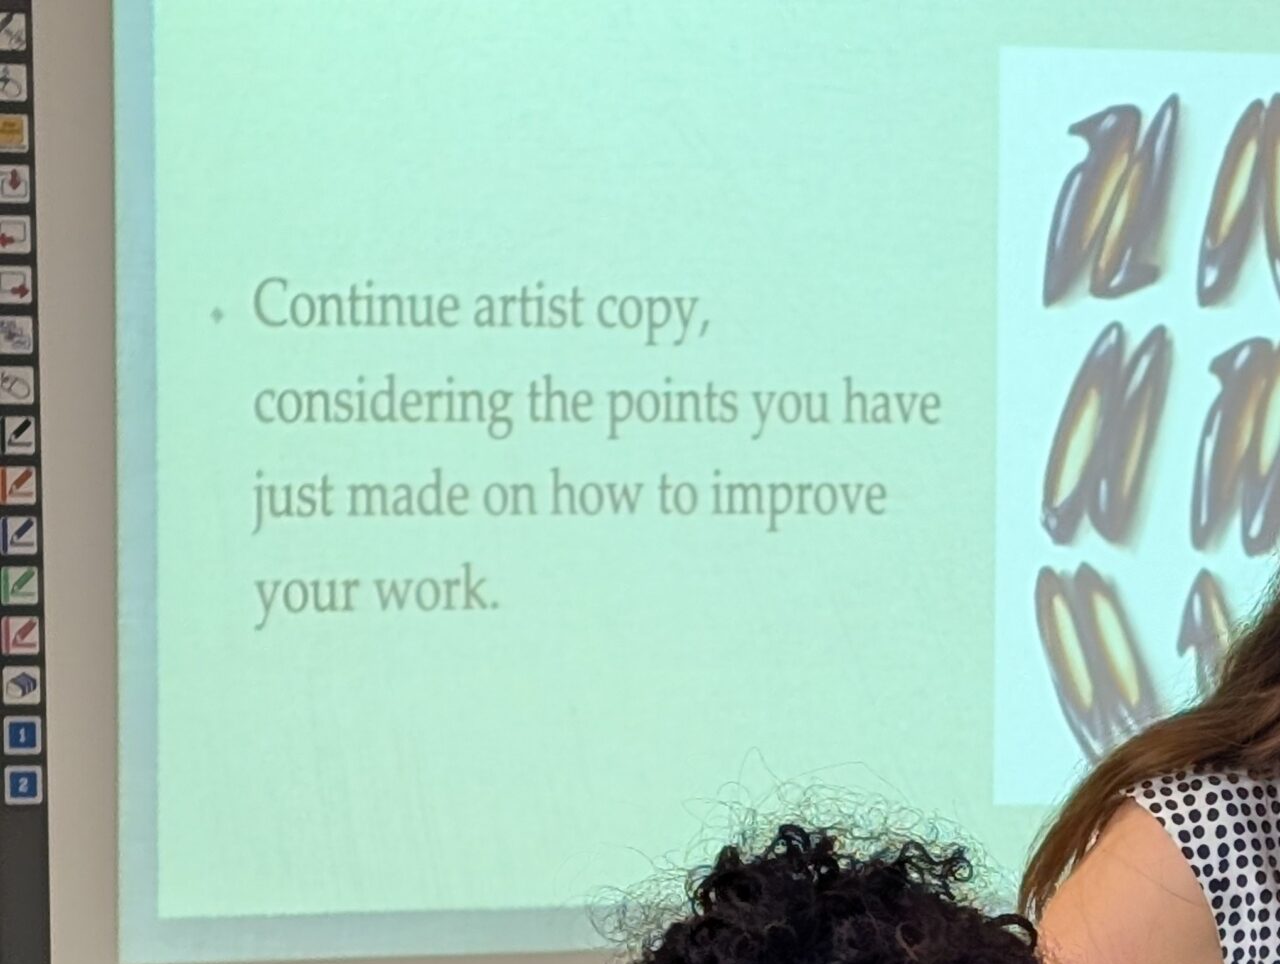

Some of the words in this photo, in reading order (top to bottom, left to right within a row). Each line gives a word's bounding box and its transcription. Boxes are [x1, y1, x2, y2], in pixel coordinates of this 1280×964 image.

[253, 276, 460, 330] Continue
[473, 280, 585, 329] artist
[597, 292, 711, 346] copy,
[253, 374, 514, 440] considering
[528, 374, 594, 424] the
[607, 380, 739, 440] points
[752, 388, 831, 440] you
[843, 377, 942, 425] have
[251, 470, 335, 535] just
[346, 469, 470, 518] made
[483, 481, 539, 517] on
[549, 467, 644, 516] how
[658, 473, 699, 516] to
[711, 470, 889, 533] improve
[254, 574, 361, 632] your
[373, 562, 500, 613] work.
